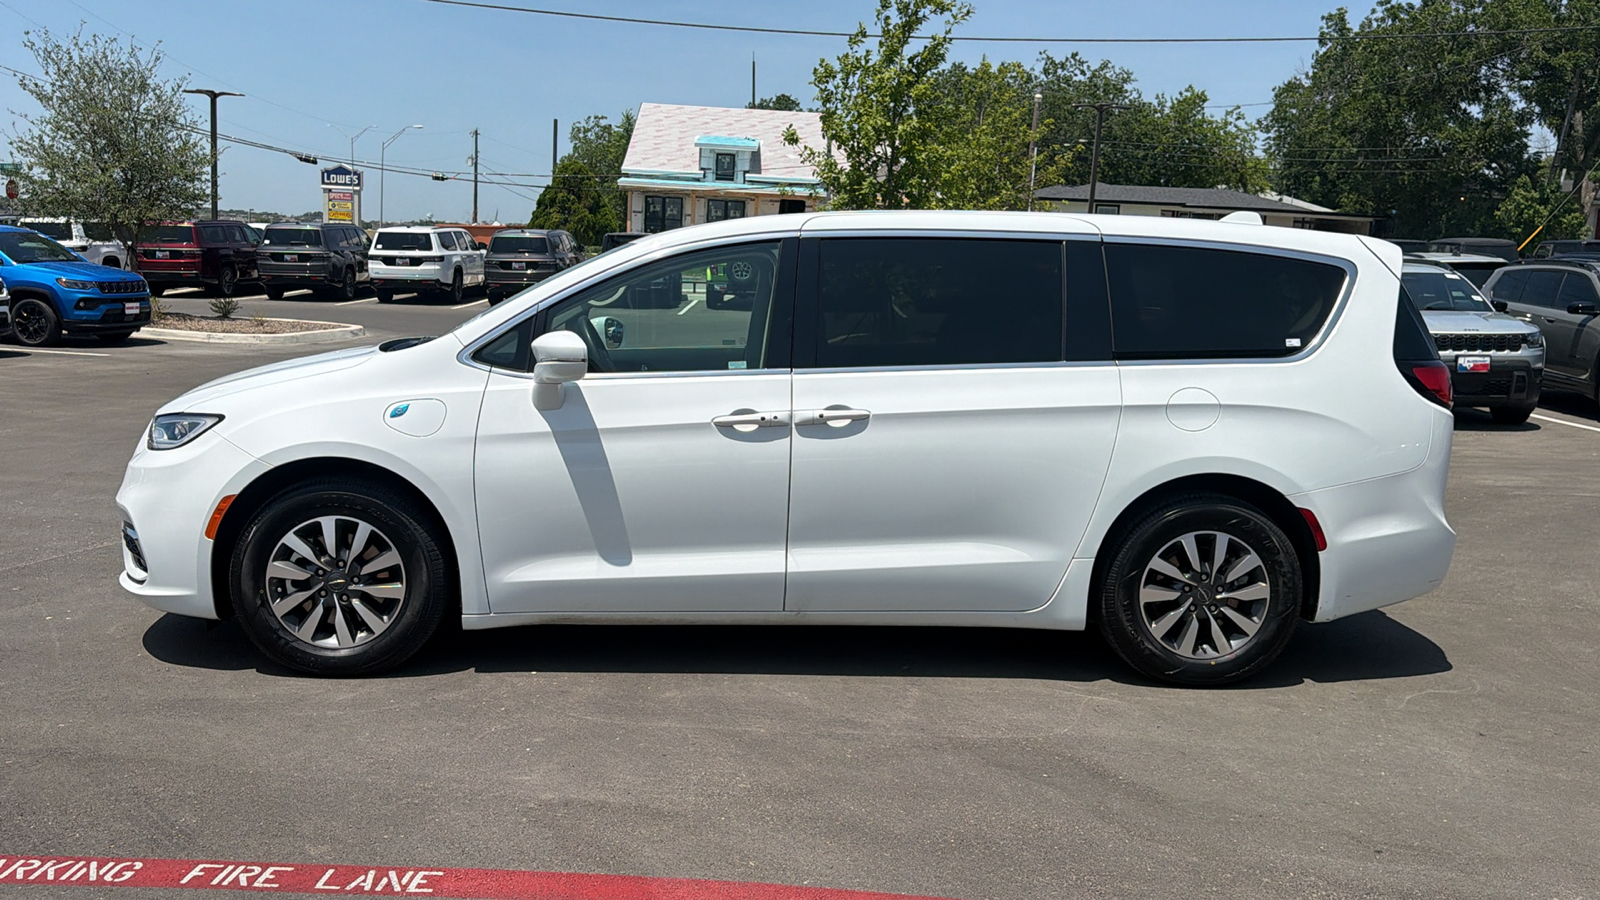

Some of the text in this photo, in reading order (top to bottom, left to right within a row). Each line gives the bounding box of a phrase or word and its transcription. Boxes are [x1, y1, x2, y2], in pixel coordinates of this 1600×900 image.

[0, 859, 444, 894] RKING FIRE LANE
